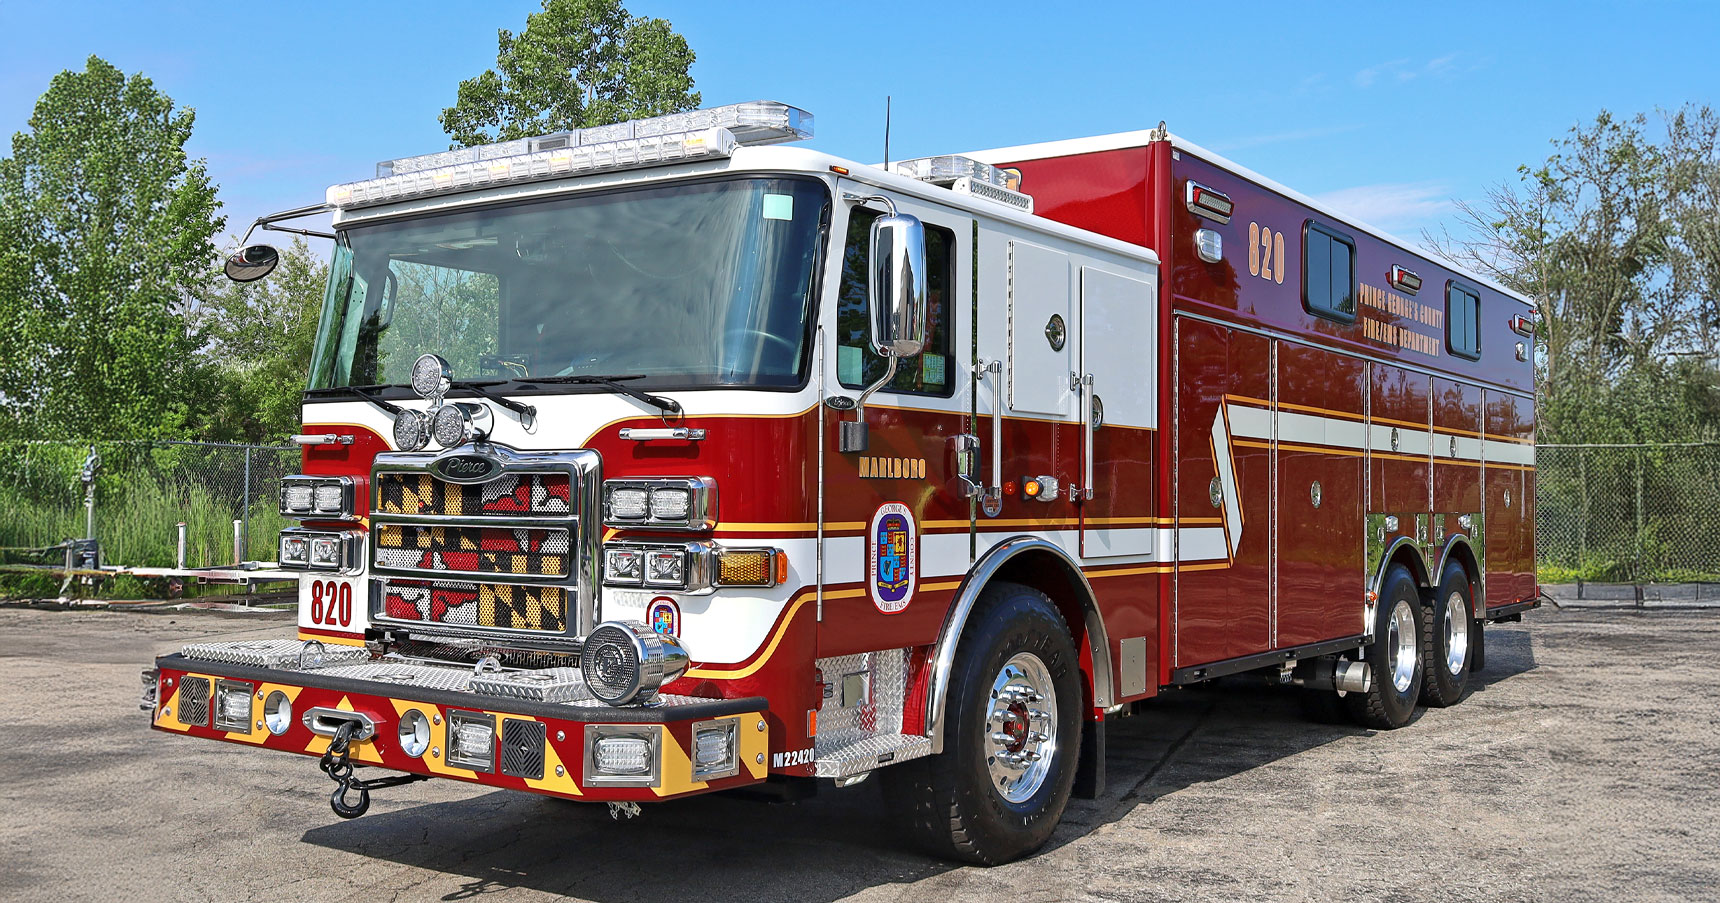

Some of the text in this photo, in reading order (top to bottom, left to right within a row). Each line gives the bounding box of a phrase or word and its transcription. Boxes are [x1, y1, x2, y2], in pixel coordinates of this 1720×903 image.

[1248, 221, 1285, 285] 820
[1359, 282, 1443, 330] PRINCE GEORGE'S COUNTY
[1363, 316, 1440, 357] FIRE/EMS DEPARTMENT
[444, 457, 486, 475] Pierce
[858, 456, 926, 479] MARLBORO
[311, 579, 353, 628] 820
[772, 747, 815, 769] M22420
